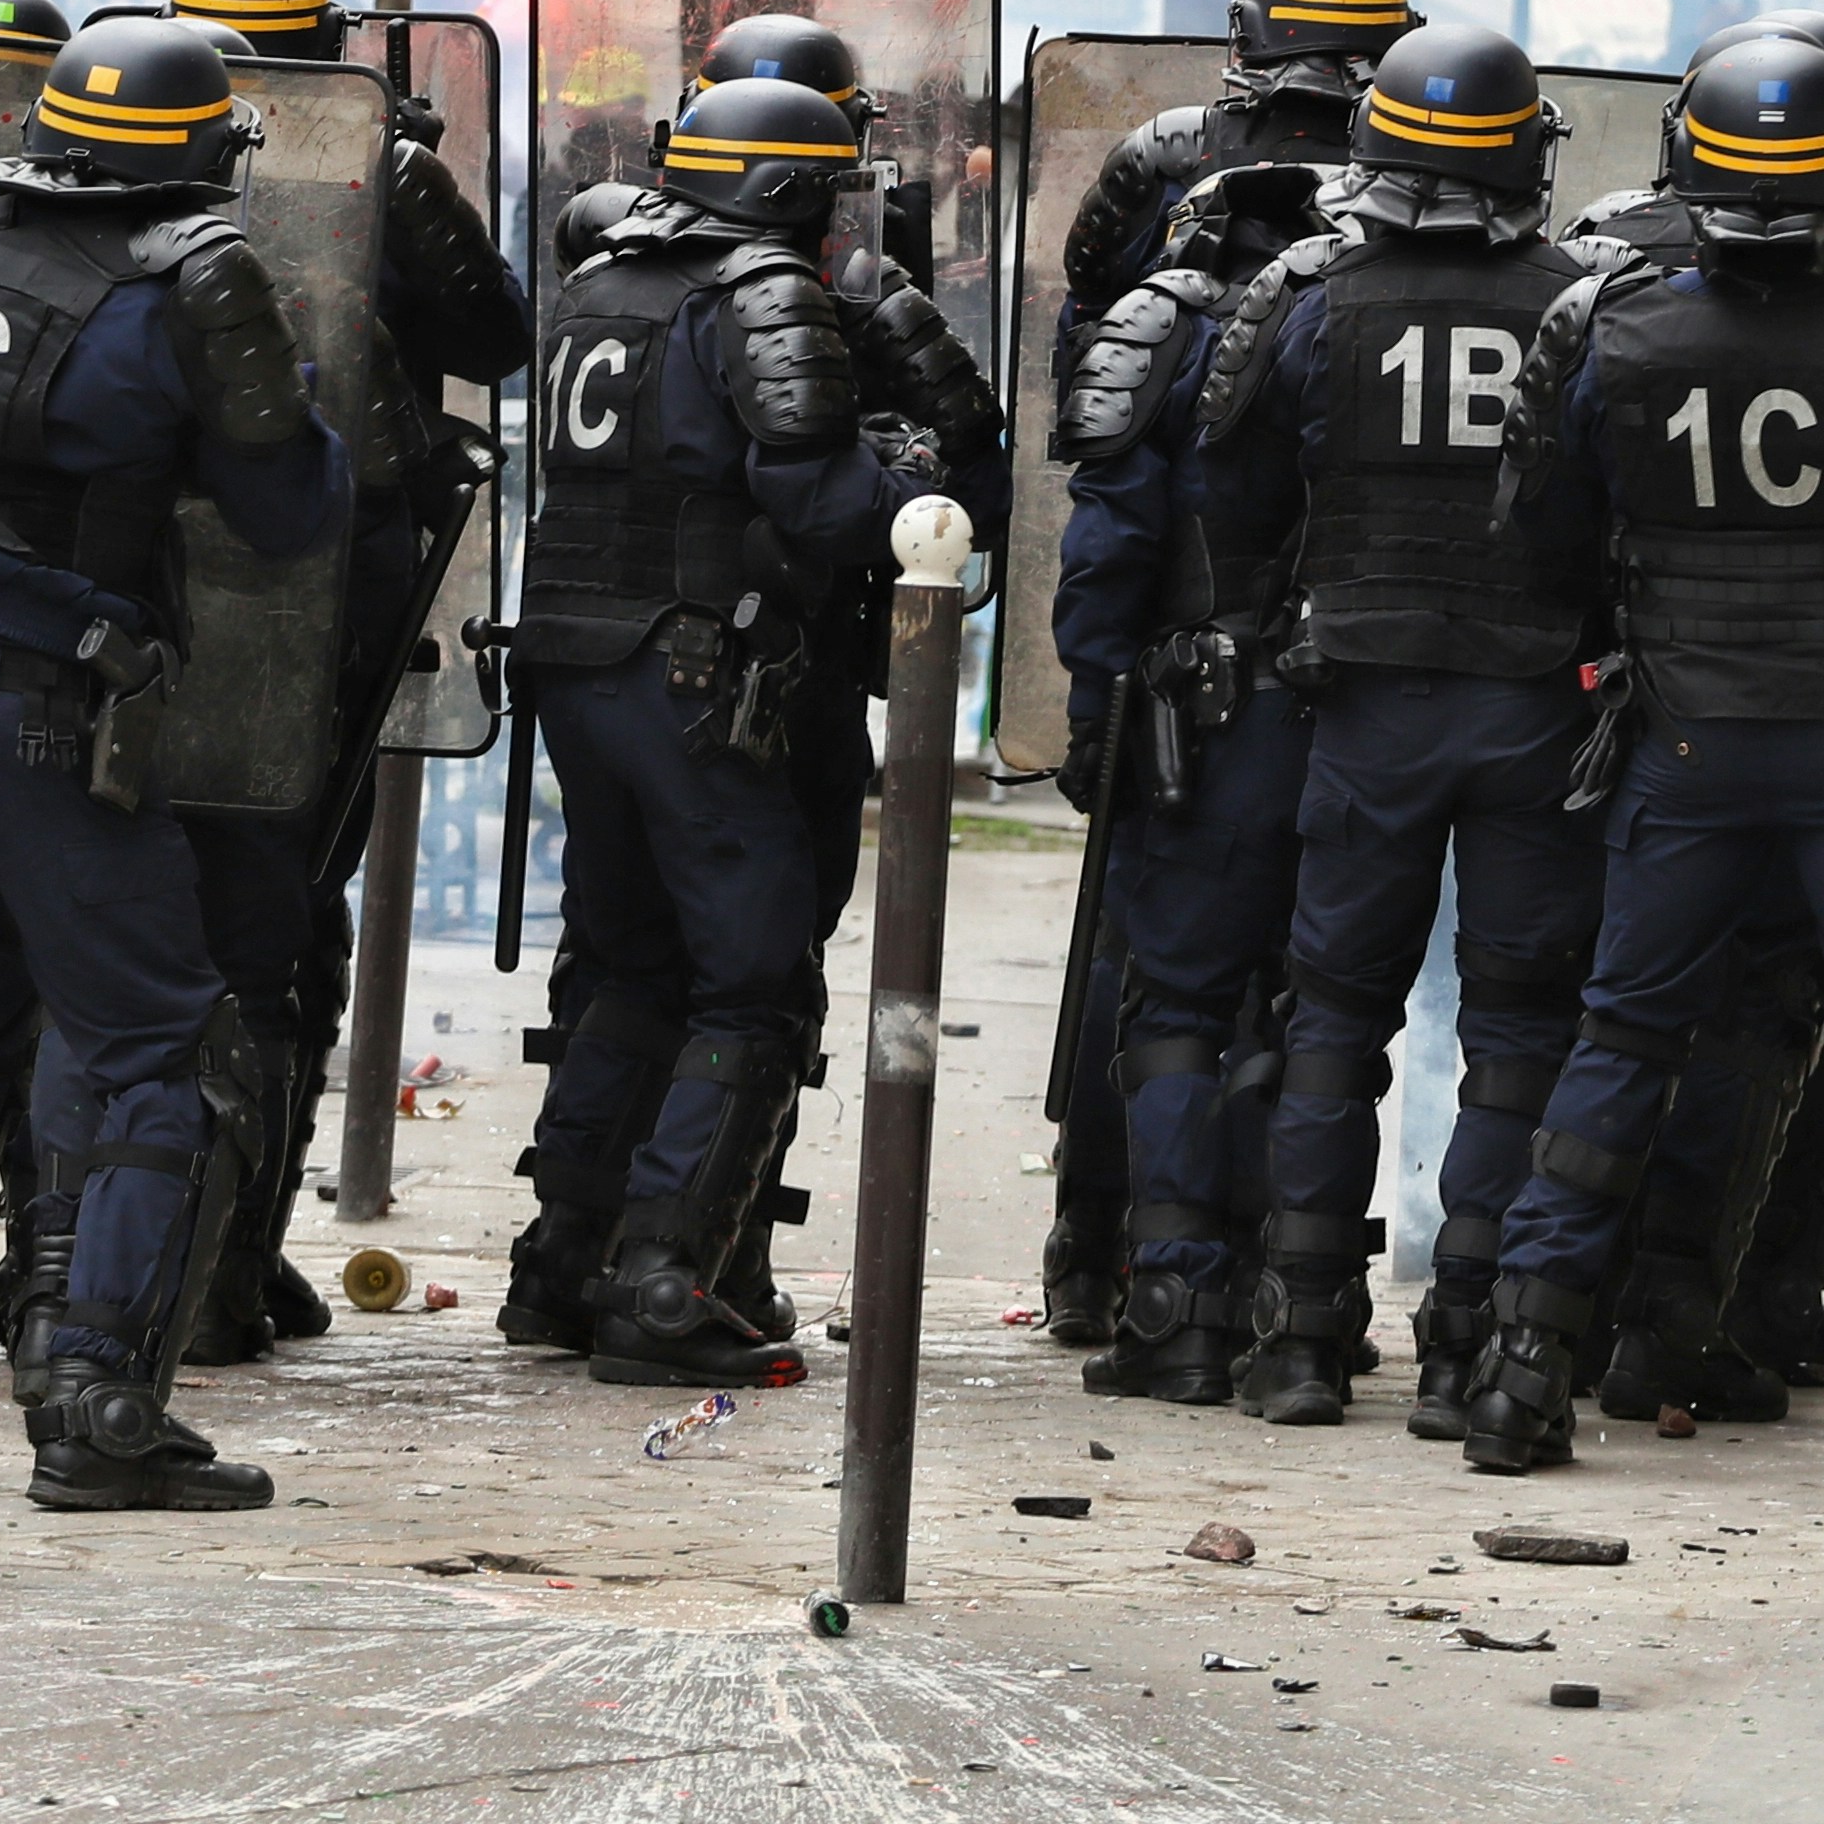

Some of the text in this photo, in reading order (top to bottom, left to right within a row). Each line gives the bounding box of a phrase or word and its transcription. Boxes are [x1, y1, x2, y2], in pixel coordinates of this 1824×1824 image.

[546, 335, 627, 451] 1C
[1381, 325, 1523, 447] 1B
[1667, 387, 1822, 508] 1C
